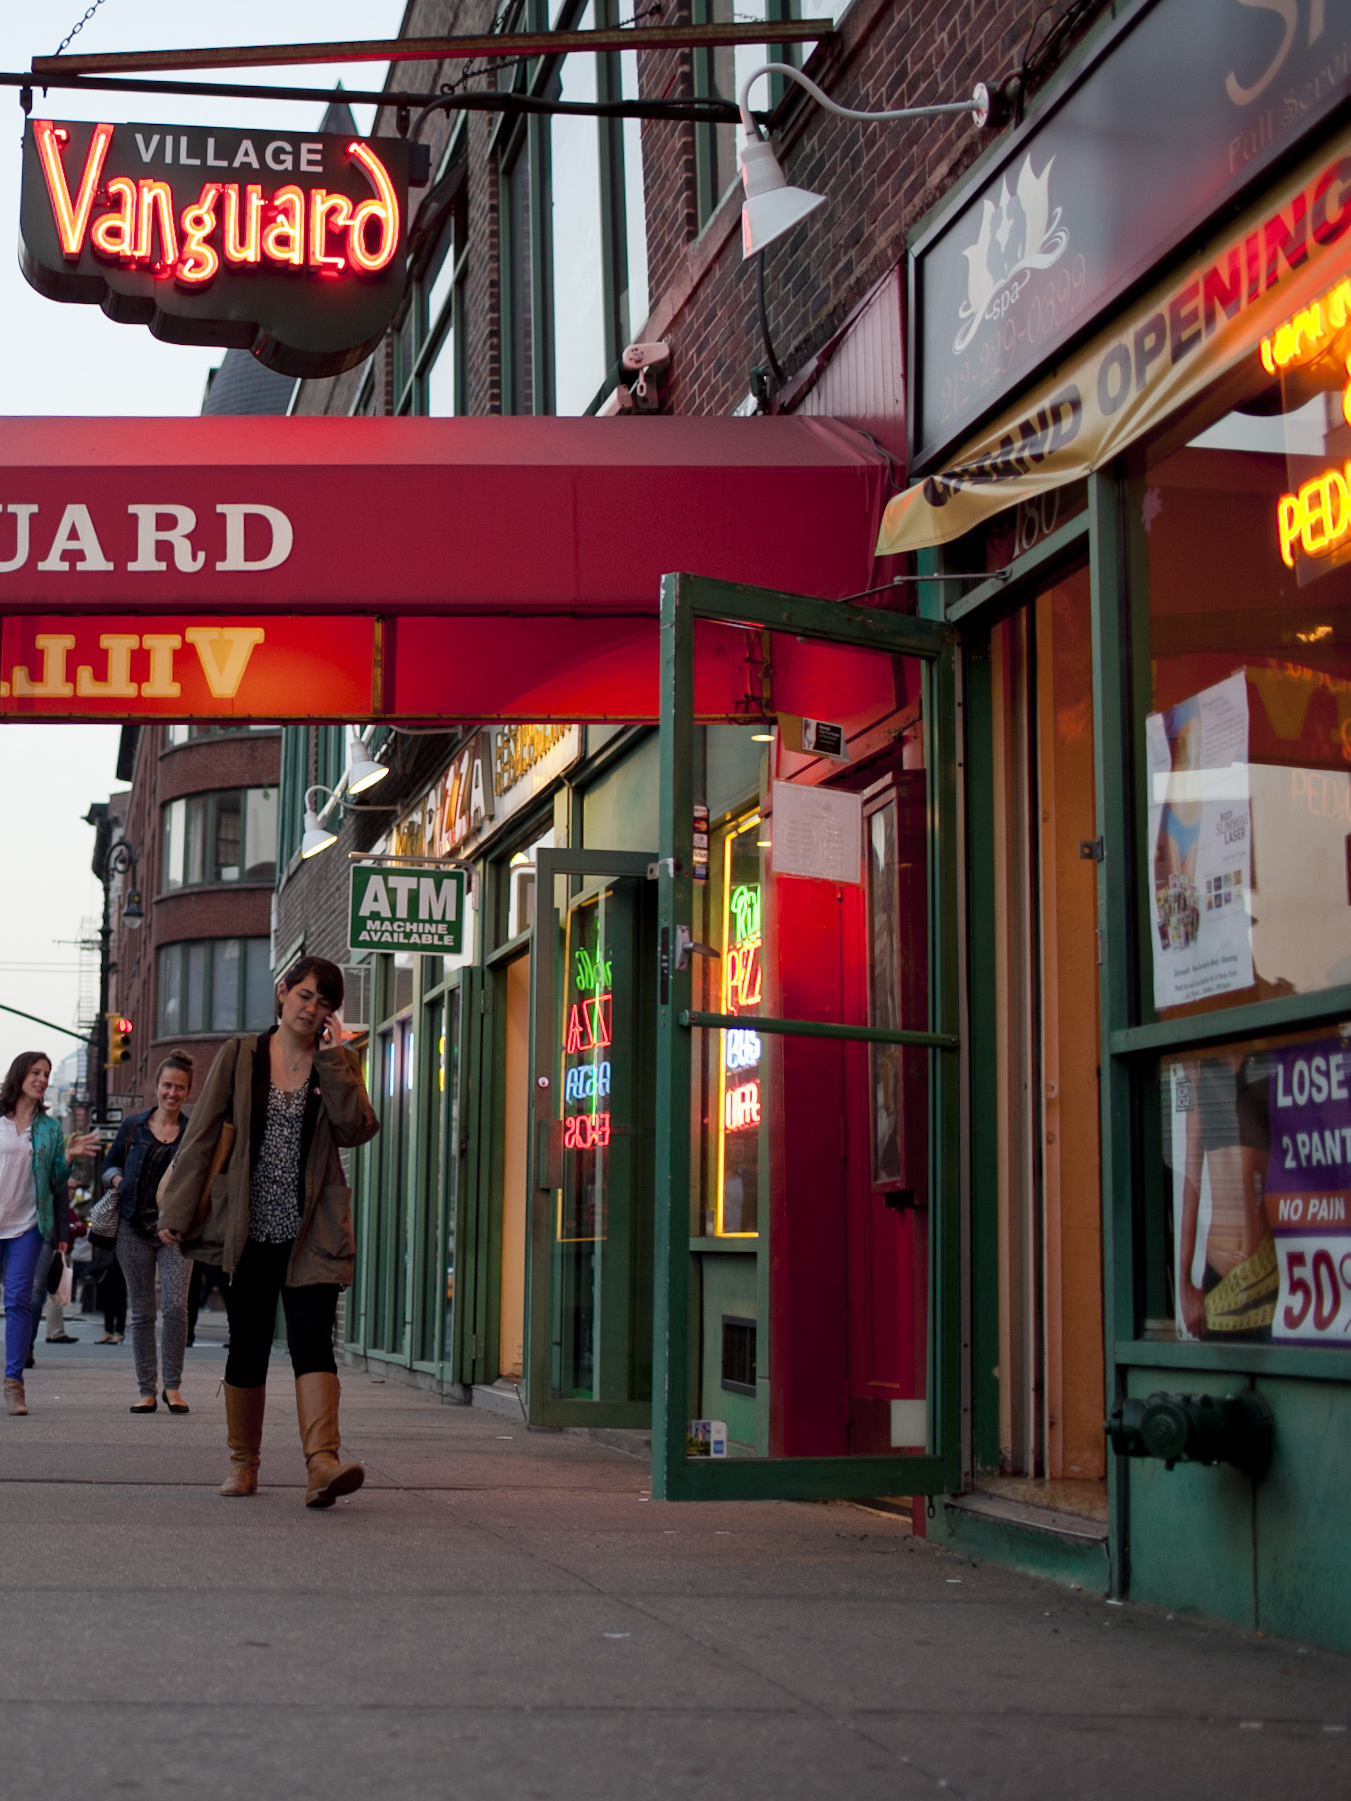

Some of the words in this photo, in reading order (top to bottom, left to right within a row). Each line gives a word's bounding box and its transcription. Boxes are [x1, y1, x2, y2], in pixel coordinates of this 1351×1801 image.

[134, 133, 323, 172] VILLAGE
[33, 120, 400, 288] Vanguard
[1097, 157, 1351, 416] OPENING
[1225, 826, 1246, 845] LASER
[358, 874, 457, 921] ATM
[358, 930, 454, 945] AVAILABLE
[366, 920, 448, 934] MACHINE
[1277, 1053, 1348, 1108] LOSE
[1282, 1136, 1296, 1169] 2
[1278, 1198, 1303, 1221] NO
[1307, 1196, 1345, 1221] PAIN
